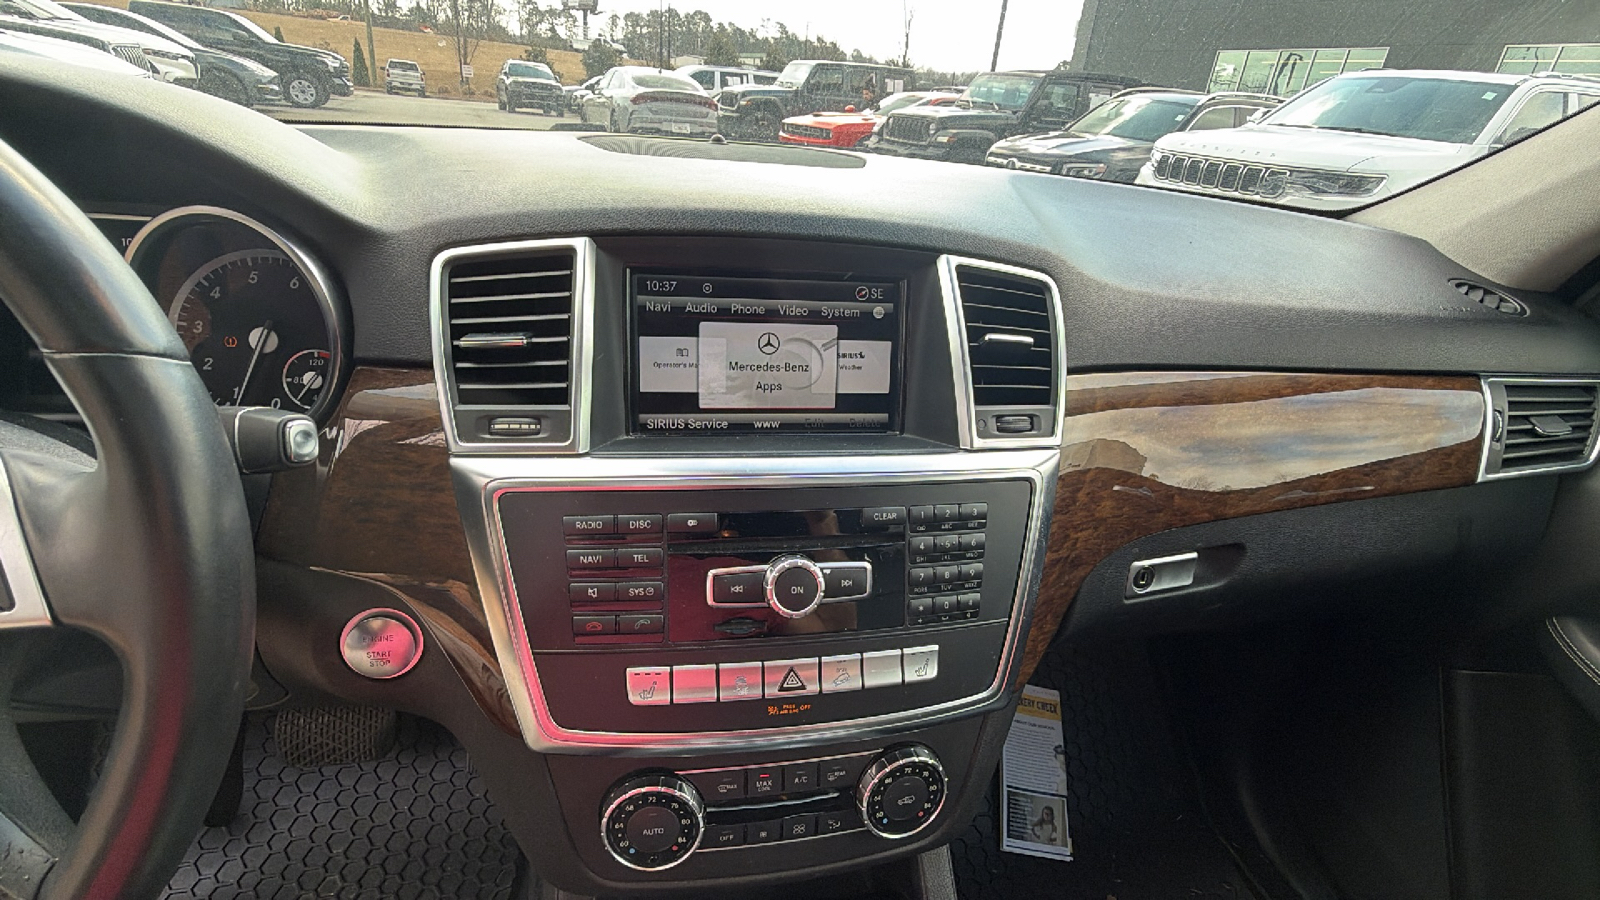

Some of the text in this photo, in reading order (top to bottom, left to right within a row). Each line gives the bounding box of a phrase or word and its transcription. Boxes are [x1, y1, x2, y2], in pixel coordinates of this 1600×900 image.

[248, 271, 258, 284] 5
[289, 277, 299, 289] 6
[645, 280, 677, 292] 10:37
[209, 286, 221, 299] 4
[870, 288, 884, 299] SE
[645, 302, 860, 319] Navi Audio Phone Video System
[193, 320, 203, 334] 3
[202, 357, 214, 370] 2
[728, 361, 809, 372] Mercedes-Benz
[755, 380, 783, 392] Apps
[233, 386, 239, 399] 1
[271, 398, 281, 409] 0
[647, 418, 729, 429] SIRIUS Service
[753, 419, 781, 429] www
[804, 418, 825, 428] Edit
[849, 418, 881, 428] Delete
[945, 510, 951, 518] 2
[972, 508, 978, 516] 3
[575, 521, 603, 529] RADIO
[629, 520, 652, 529] DISC
[919, 542, 925, 550] 4
[945, 540, 951, 548] 5
[971, 538, 977, 546] 6
[580, 555, 602, 564] NAVI
[633, 554, 649, 562] TEL
[919, 572, 925, 581] 7
[945, 571, 950, 579] 8
[969, 568, 975, 577] 9
[628, 588, 644, 596] SYS
[944, 601, 949, 609] 0
[363, 635, 394, 643] ENGINE
[756, 780, 773, 788] MAX
[643, 827, 664, 836] AUTO
[719, 834, 734, 842] OFF
